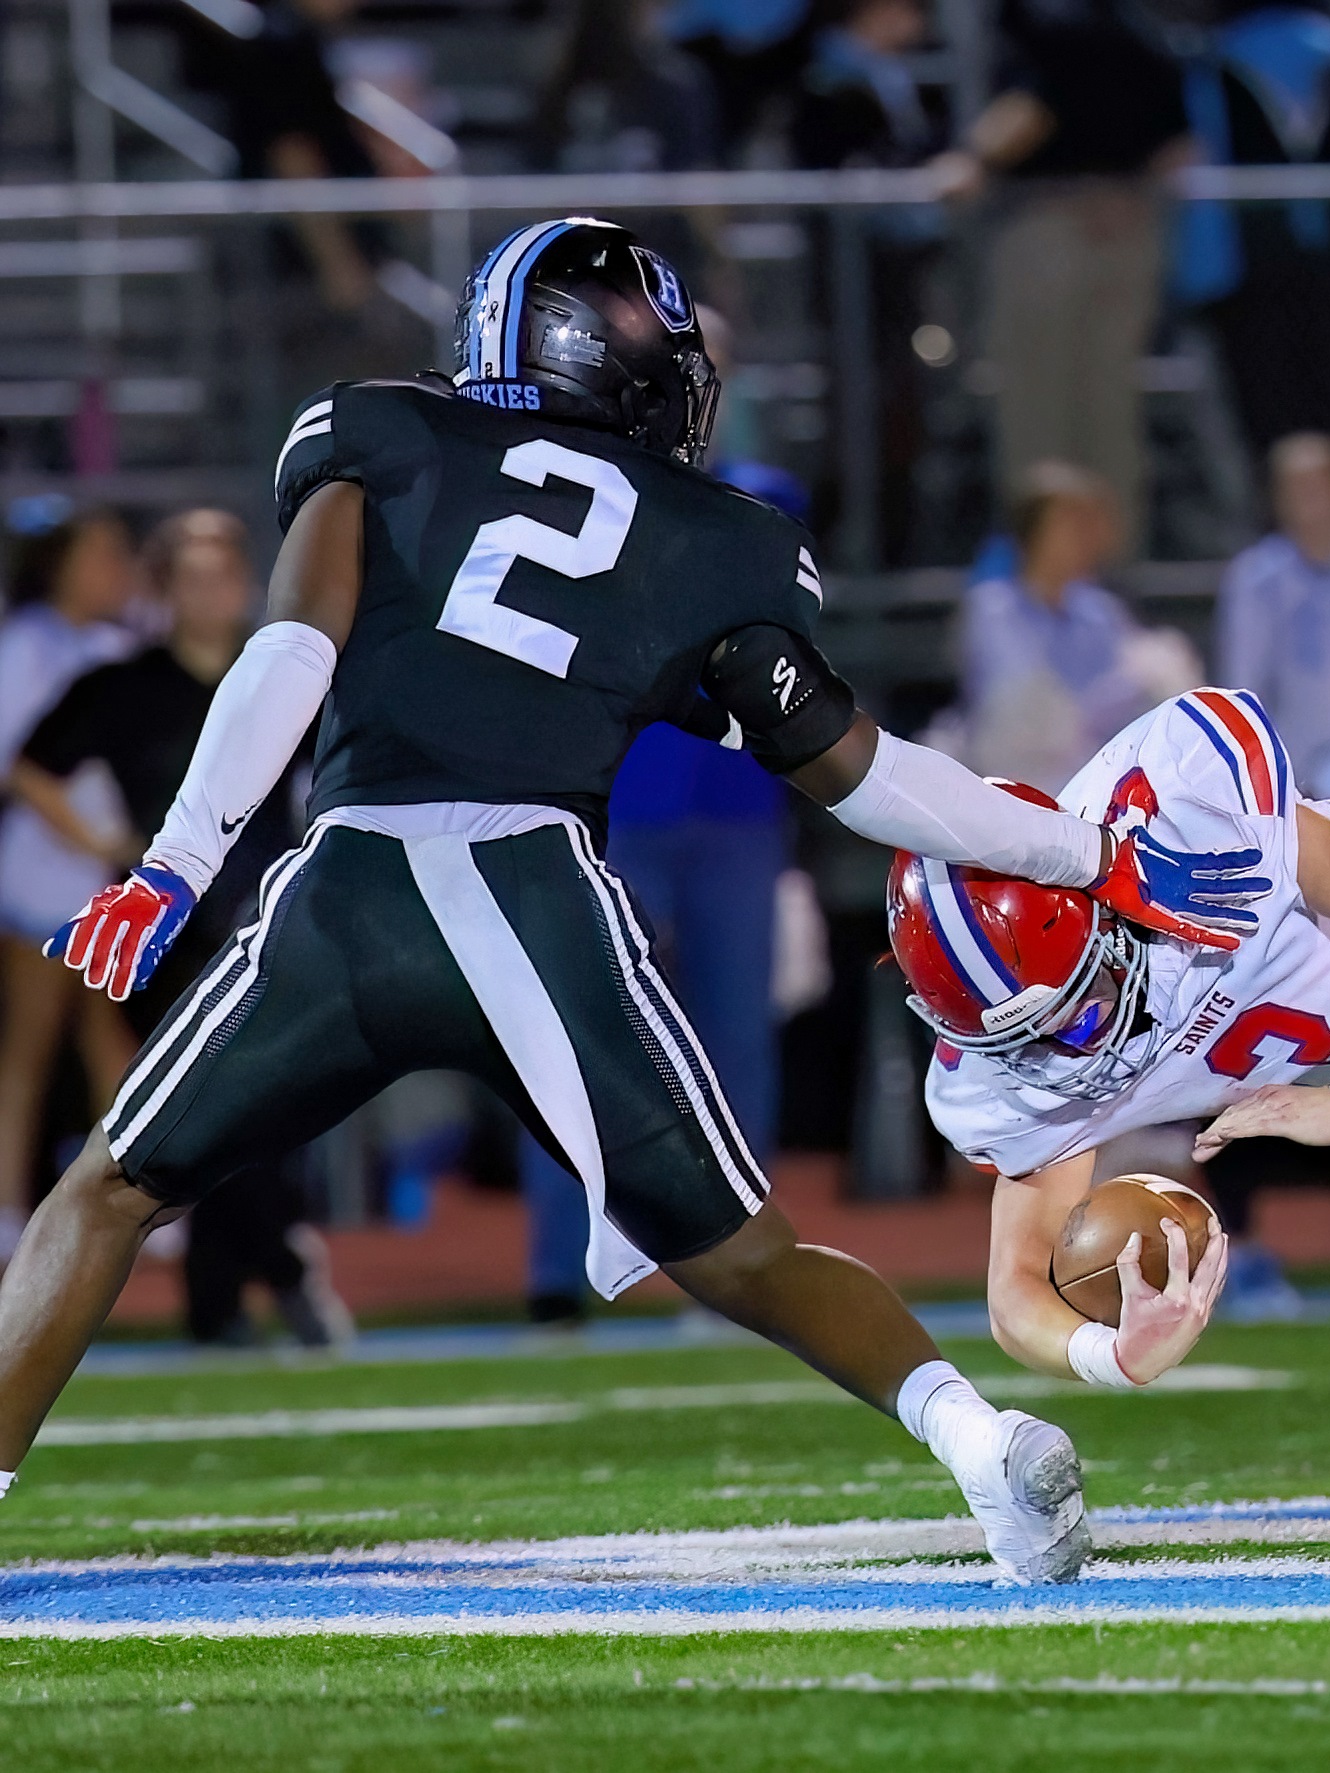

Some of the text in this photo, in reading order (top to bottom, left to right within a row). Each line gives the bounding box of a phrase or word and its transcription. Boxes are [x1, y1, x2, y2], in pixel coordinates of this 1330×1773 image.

[457, 384, 540, 410] SKIES
[435, 438, 639, 680] 2
[1174, 990, 1236, 1056] SAINTS
